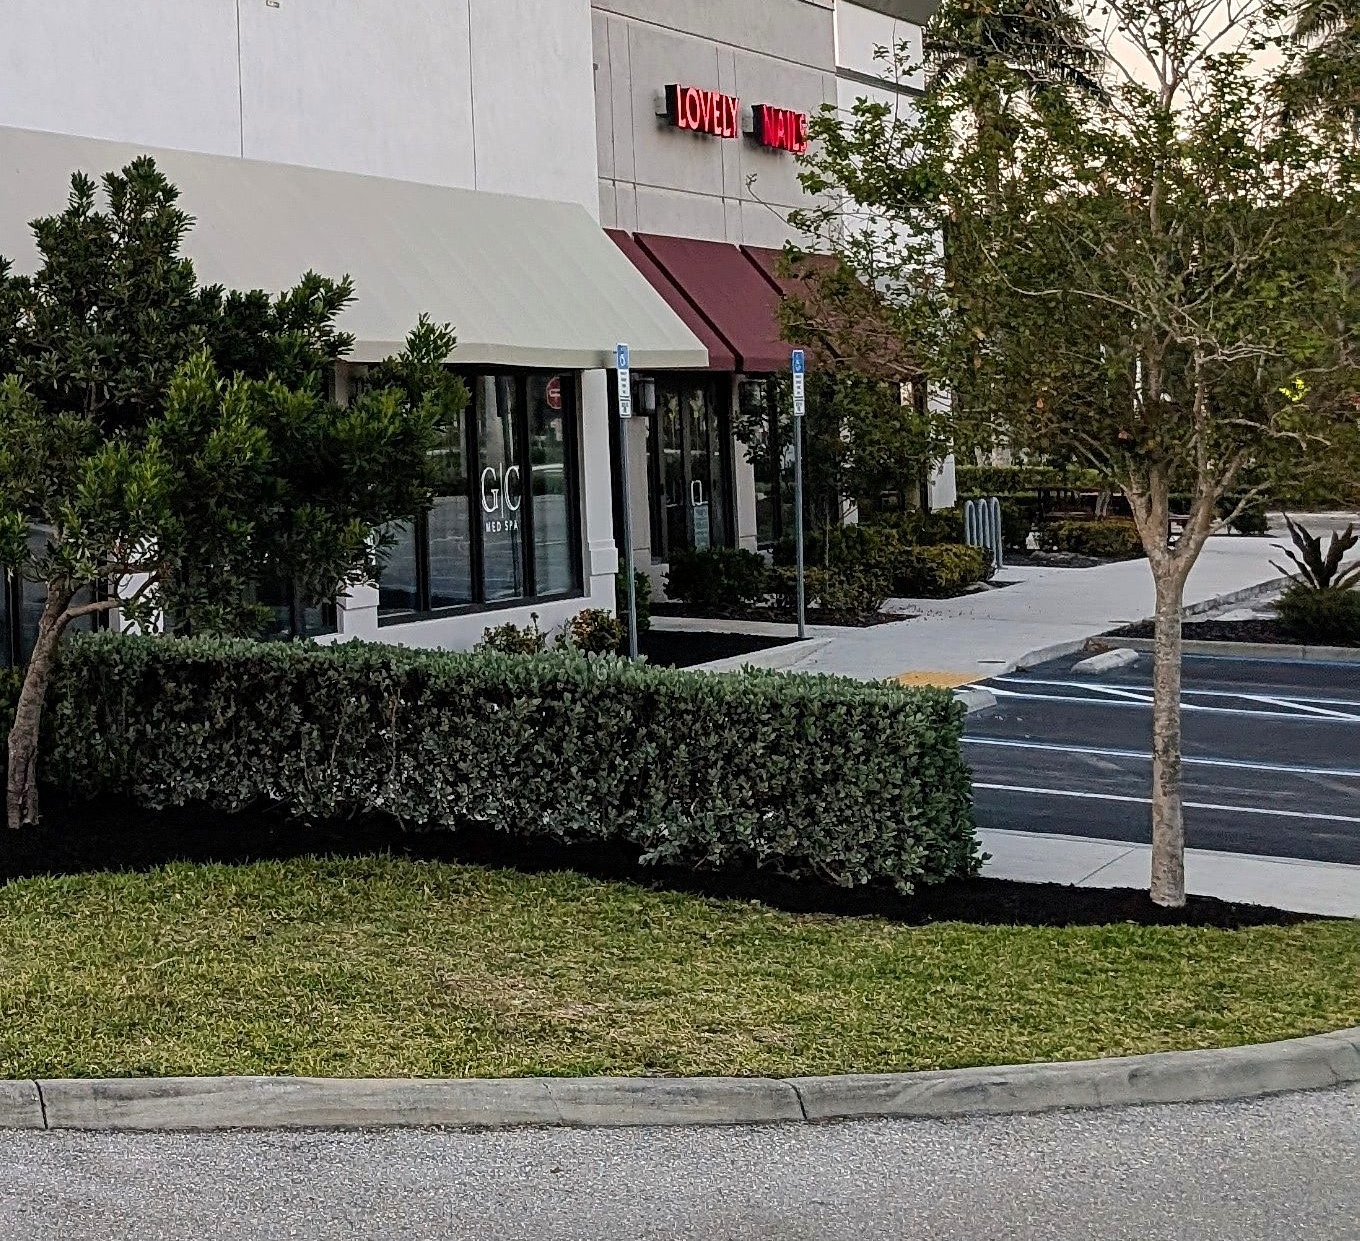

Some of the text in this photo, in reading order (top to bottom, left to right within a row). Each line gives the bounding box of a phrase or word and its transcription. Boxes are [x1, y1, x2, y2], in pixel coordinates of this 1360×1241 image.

[671, 84, 739, 138] LOVELY
[485, 519, 519, 533] MED SPA
